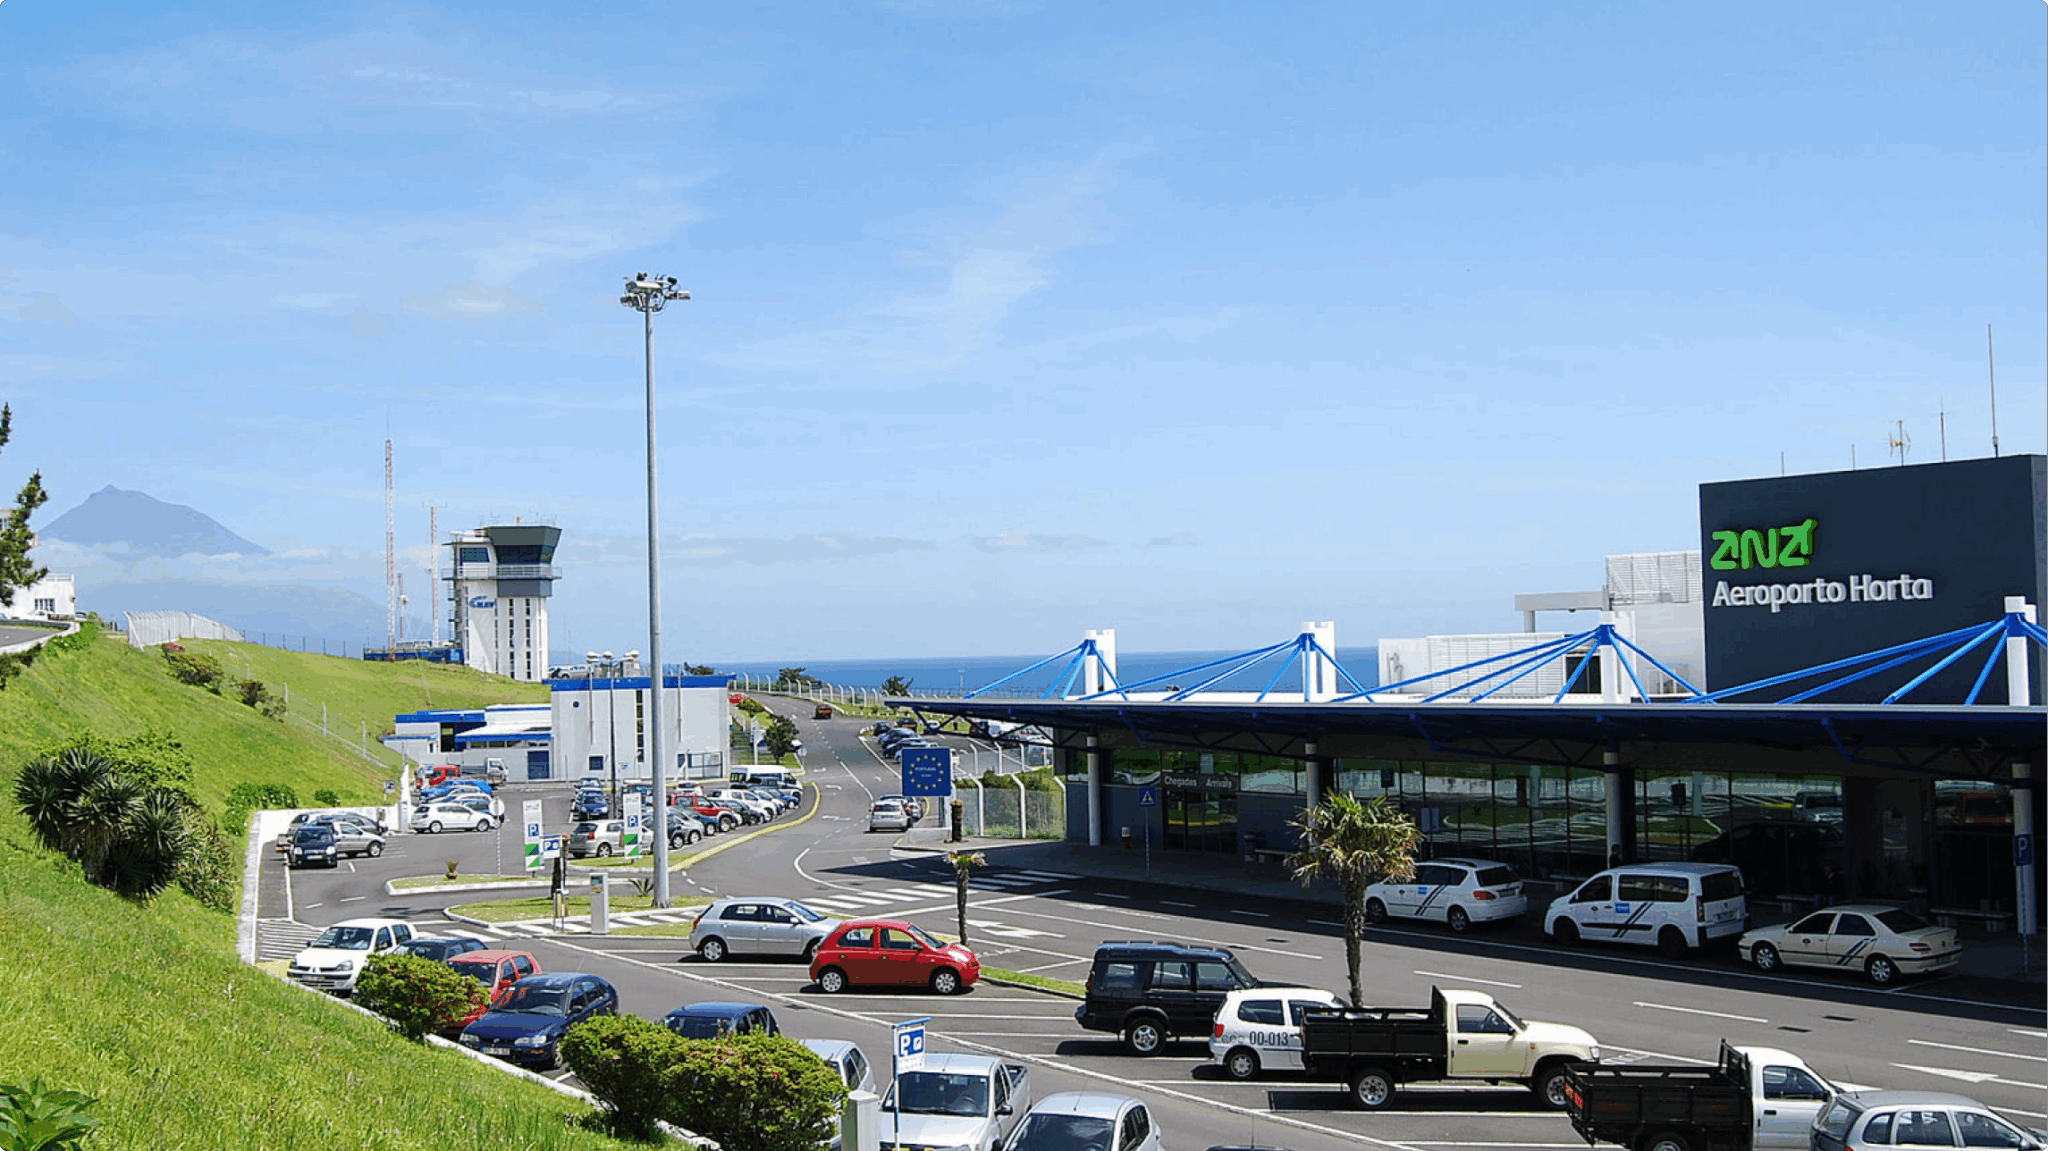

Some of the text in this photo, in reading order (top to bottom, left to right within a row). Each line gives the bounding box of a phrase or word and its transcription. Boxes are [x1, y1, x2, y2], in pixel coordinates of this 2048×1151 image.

[1712, 574, 1933, 613] Aeroporto Horta
[900, 1034, 911, 1056] P
[1249, 1031, 1289, 1046] 00-013
